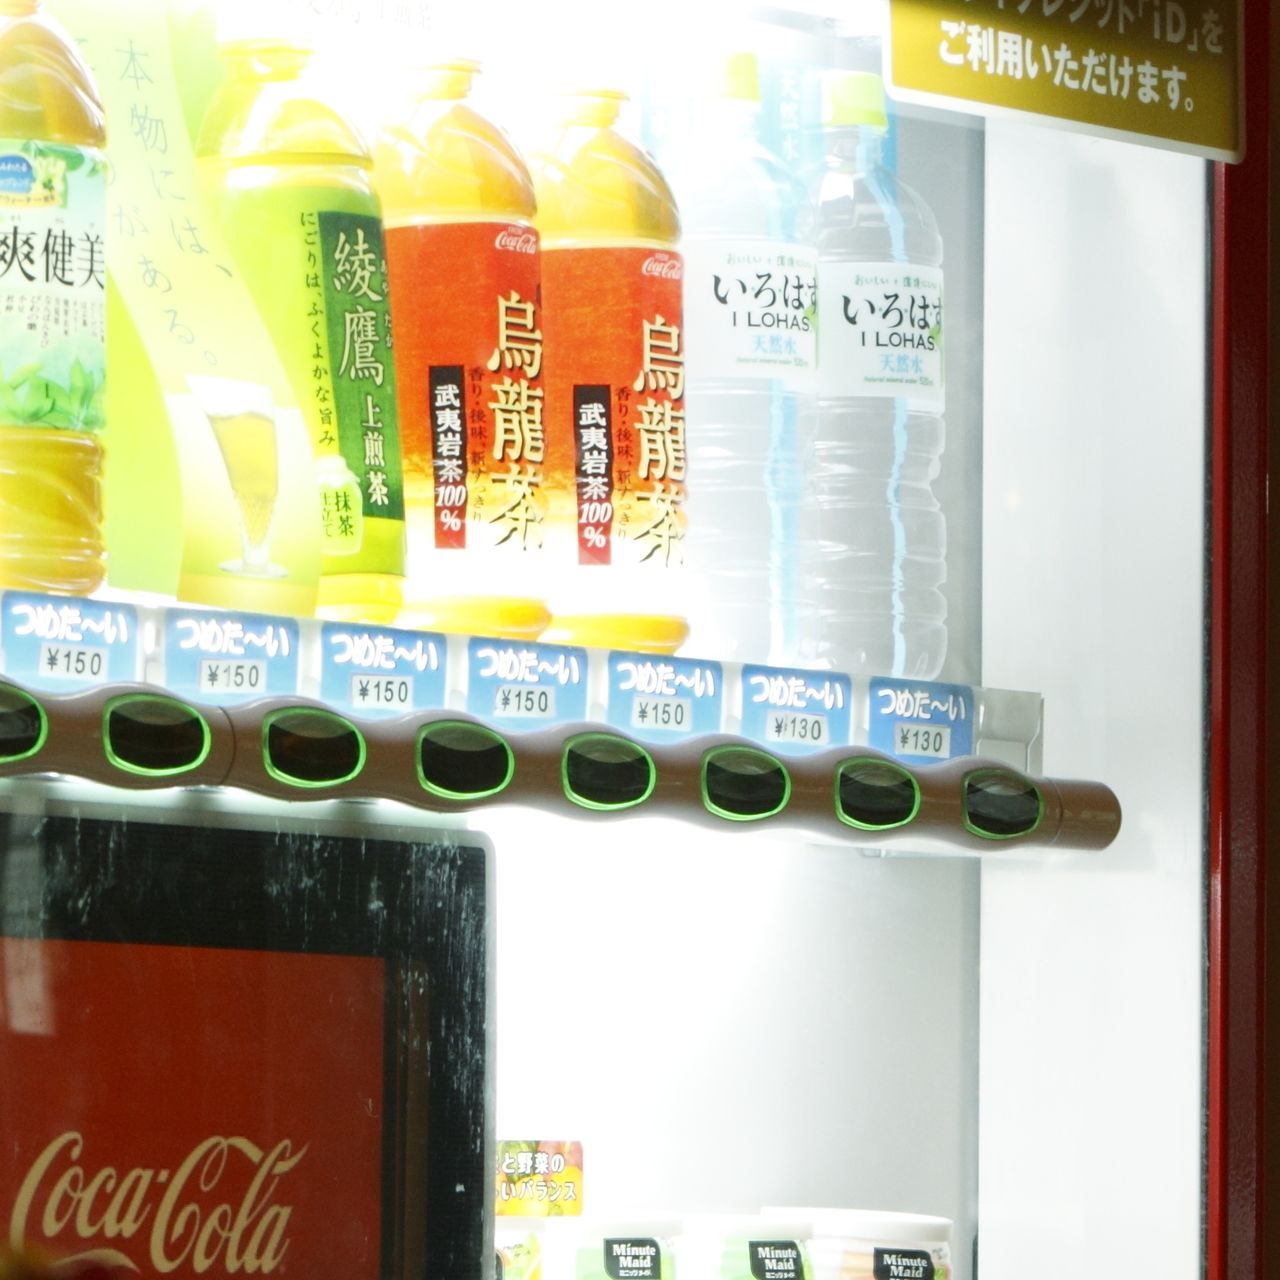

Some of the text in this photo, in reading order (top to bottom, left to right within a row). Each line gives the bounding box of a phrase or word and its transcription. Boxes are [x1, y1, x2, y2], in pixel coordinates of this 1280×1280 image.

[938, 20, 1194, 112] ご利用いただけます。
[332, 229, 386, 386] 綾鷹
[746, 311, 811, 332] LOHAS
[751, 335, 798, 356] 天然水
[875, 331, 936, 352] LOHAS
[878, 353, 924, 375] 天然水
[486, 289, 545, 552] 烏龍茶
[359, 393, 390, 507] 上煎茶
[632, 312, 688, 566] 烏龍茶
[433, 382, 467, 535] 武夷岩茶100%
[578, 400, 615, 550] 武夷岩茶100%
[46, 647, 103, 678] ¥150
[207, 662, 260, 690] ¥150
[357, 679, 410, 704] ¥150
[498, 688, 550, 715] ¥150
[637, 702, 687, 727] ¥150
[773, 715, 823, 742] ¥130
[899, 727, 945, 754] ¥130
[9, 1131, 311, 1275] Coca-Cola
[612, 1243, 656, 1257] Minute
[619, 1256, 652, 1269] Maid
[757, 1246, 798, 1259] Minute
[882, 1253, 928, 1268] Minute
[764, 1257, 795, 1271] Maid
[889, 1265, 923, 1278] Maid
